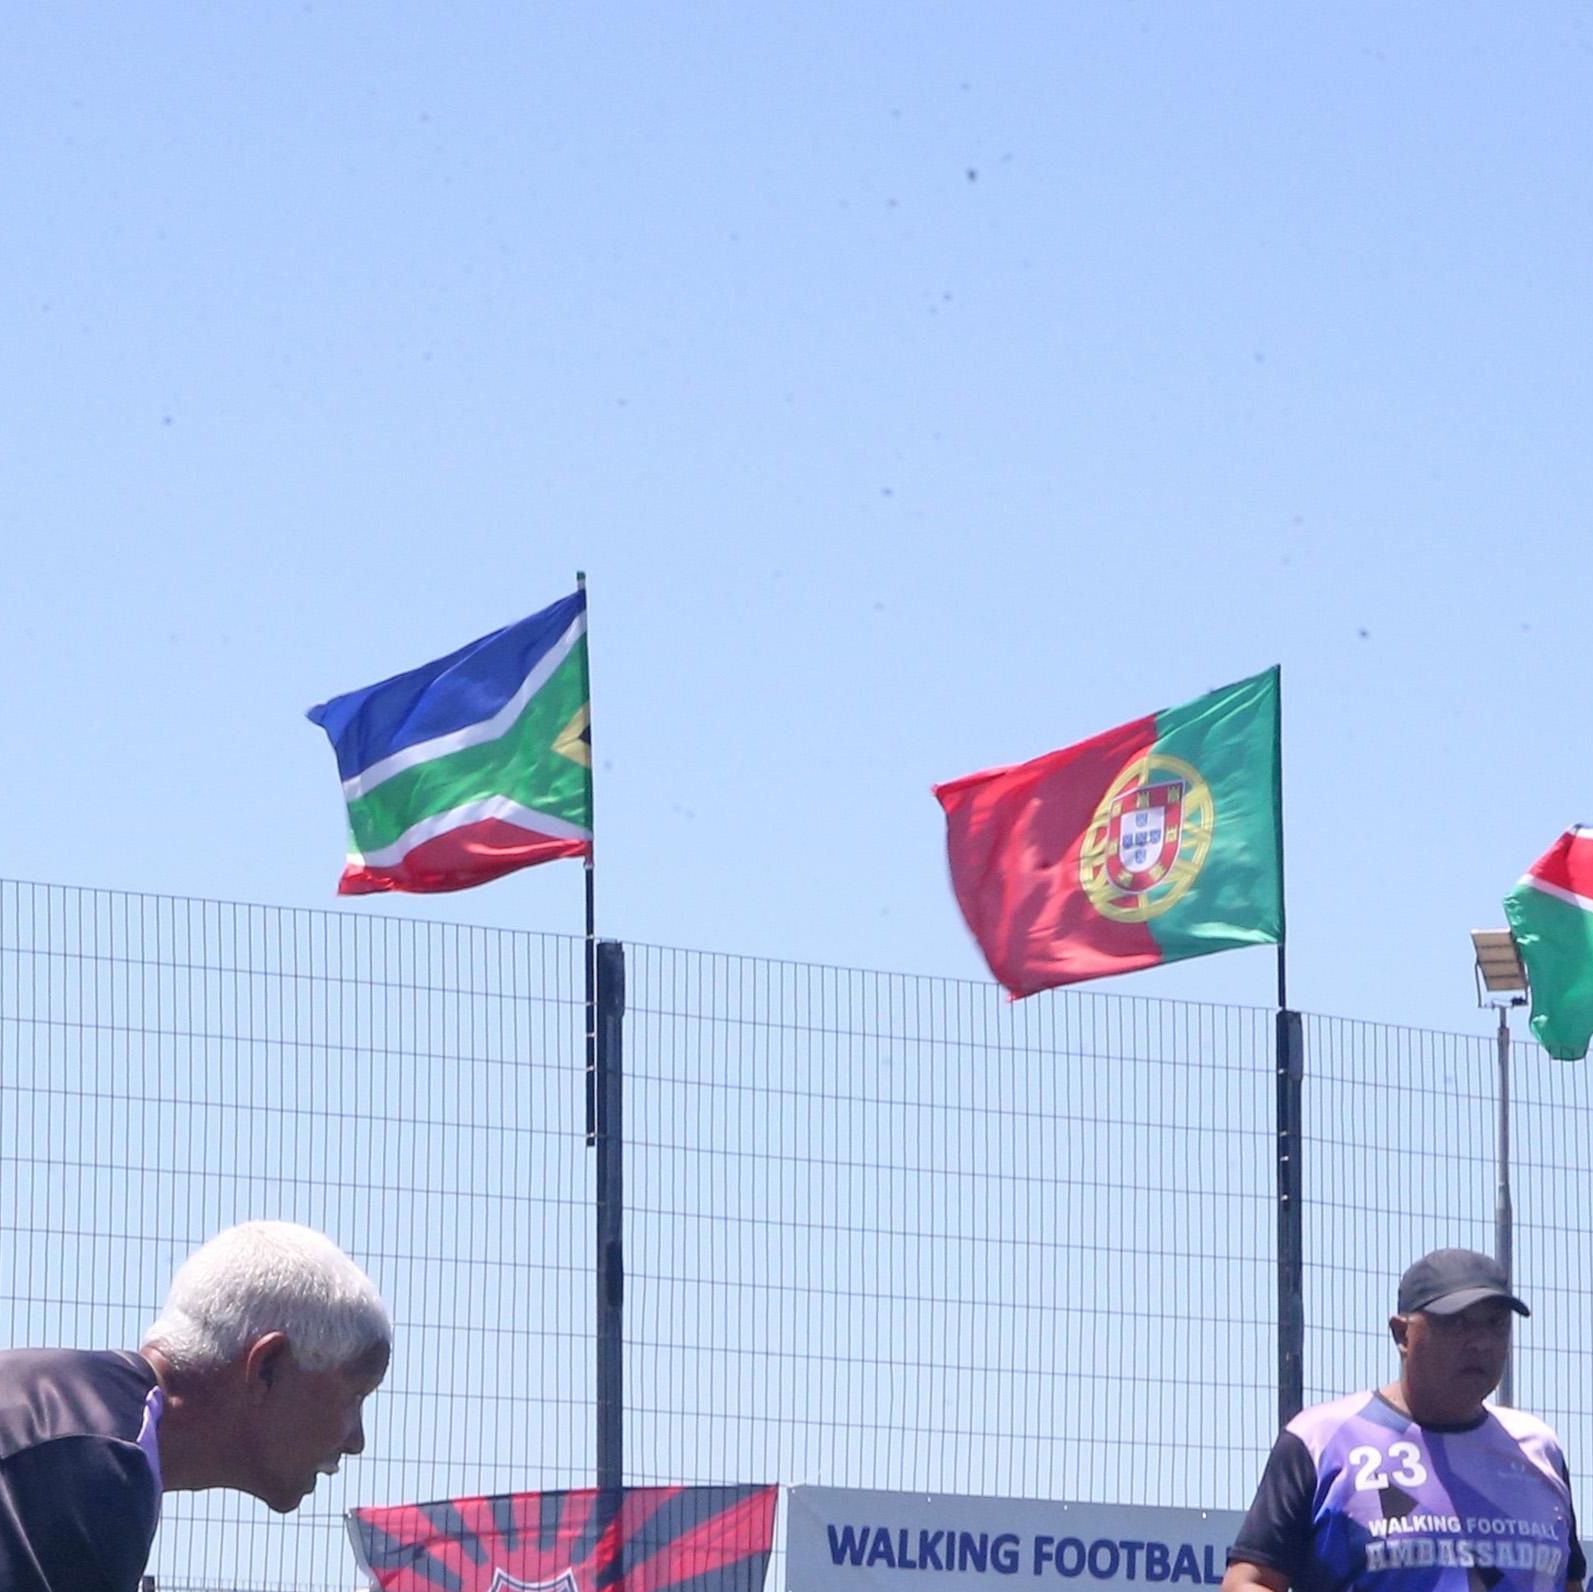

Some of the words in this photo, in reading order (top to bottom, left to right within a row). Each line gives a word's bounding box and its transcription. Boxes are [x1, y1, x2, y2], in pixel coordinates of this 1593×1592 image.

[1348, 1440, 1429, 1492] 23
[1367, 1514, 1462, 1538] WALKING
[1465, 1516, 1560, 1541] FOOTBALL
[826, 1523, 1021, 1575] WALKING
[1032, 1534, 1231, 1586] FOOTBAL
[1364, 1537, 1562, 1576] AMBASSADOR
